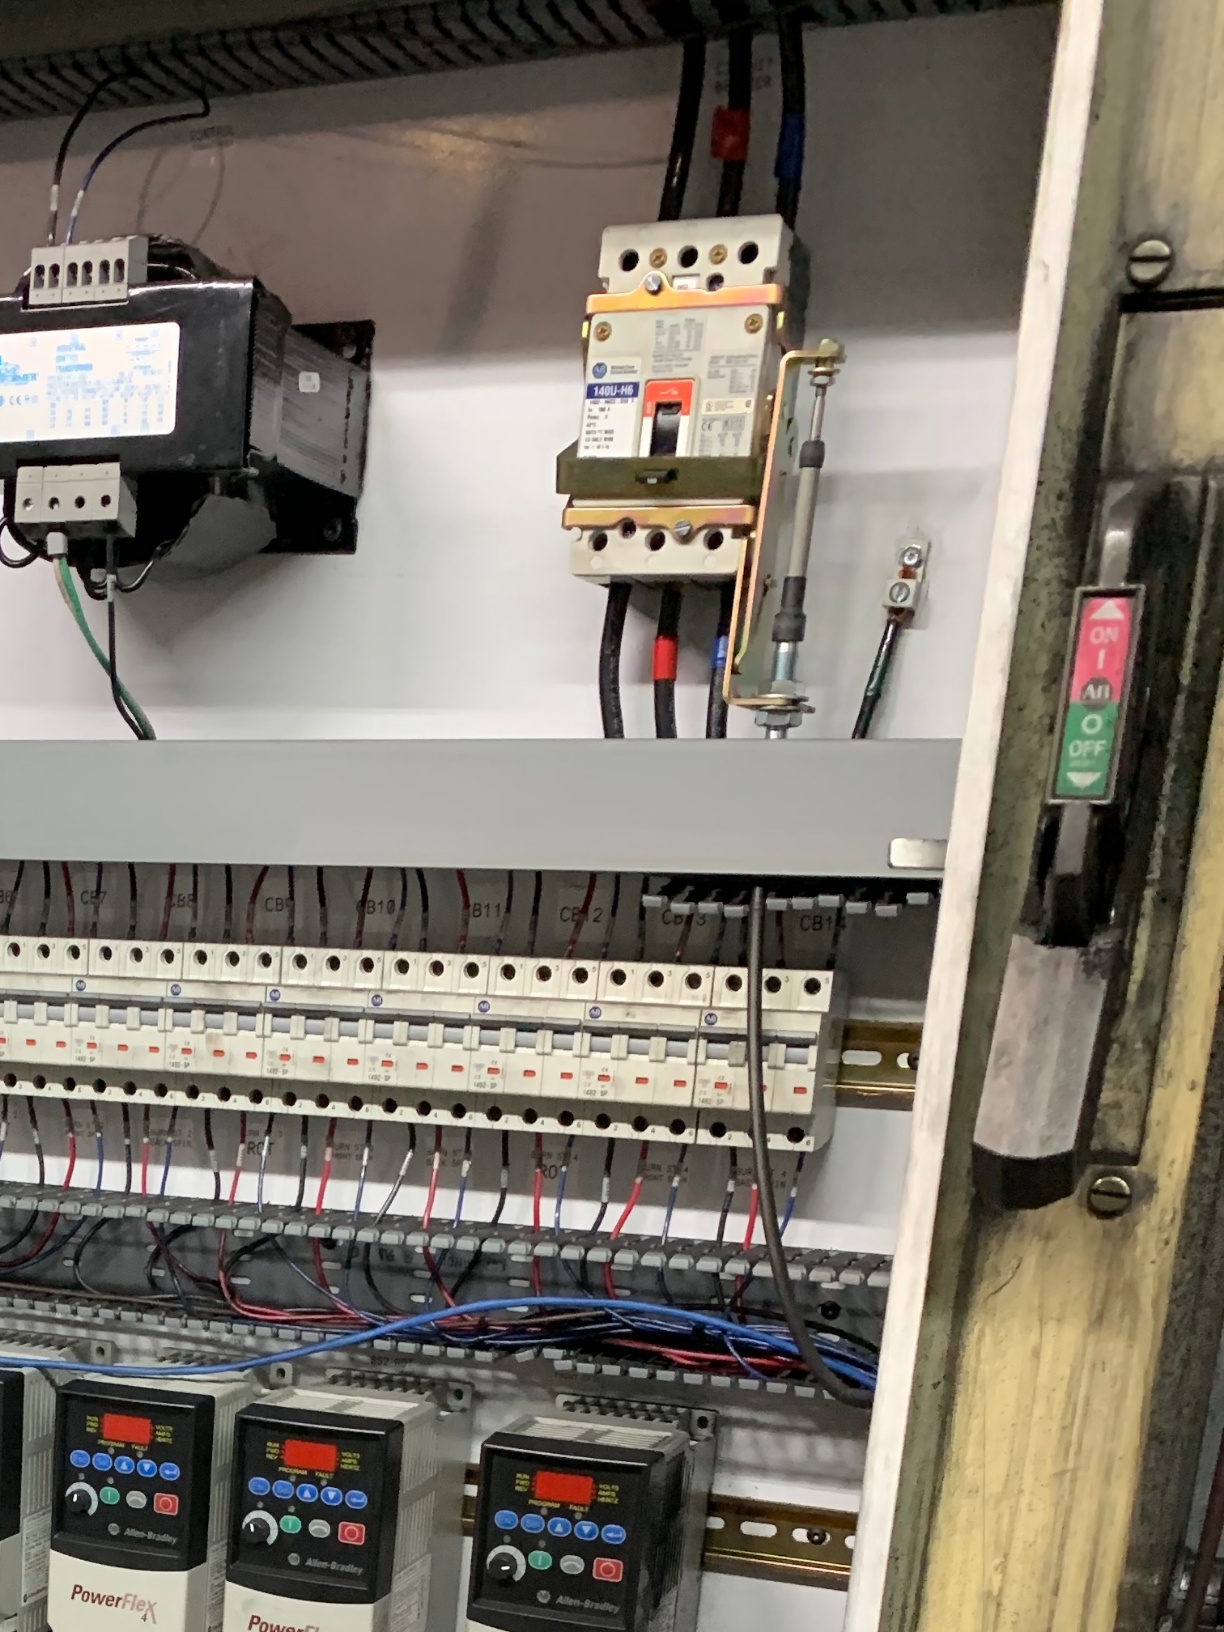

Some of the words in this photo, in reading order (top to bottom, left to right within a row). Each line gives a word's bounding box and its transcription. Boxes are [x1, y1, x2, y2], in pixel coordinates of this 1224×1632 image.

[593, 385, 634, 396] 140U-H6
[1090, 626, 1119, 645] ON
[1069, 739, 1107, 758] OFF
[560, 906, 604, 924] CB2
[662, 908, 705, 926] CB3
[70, 1584, 157, 1625] PowerFlex
